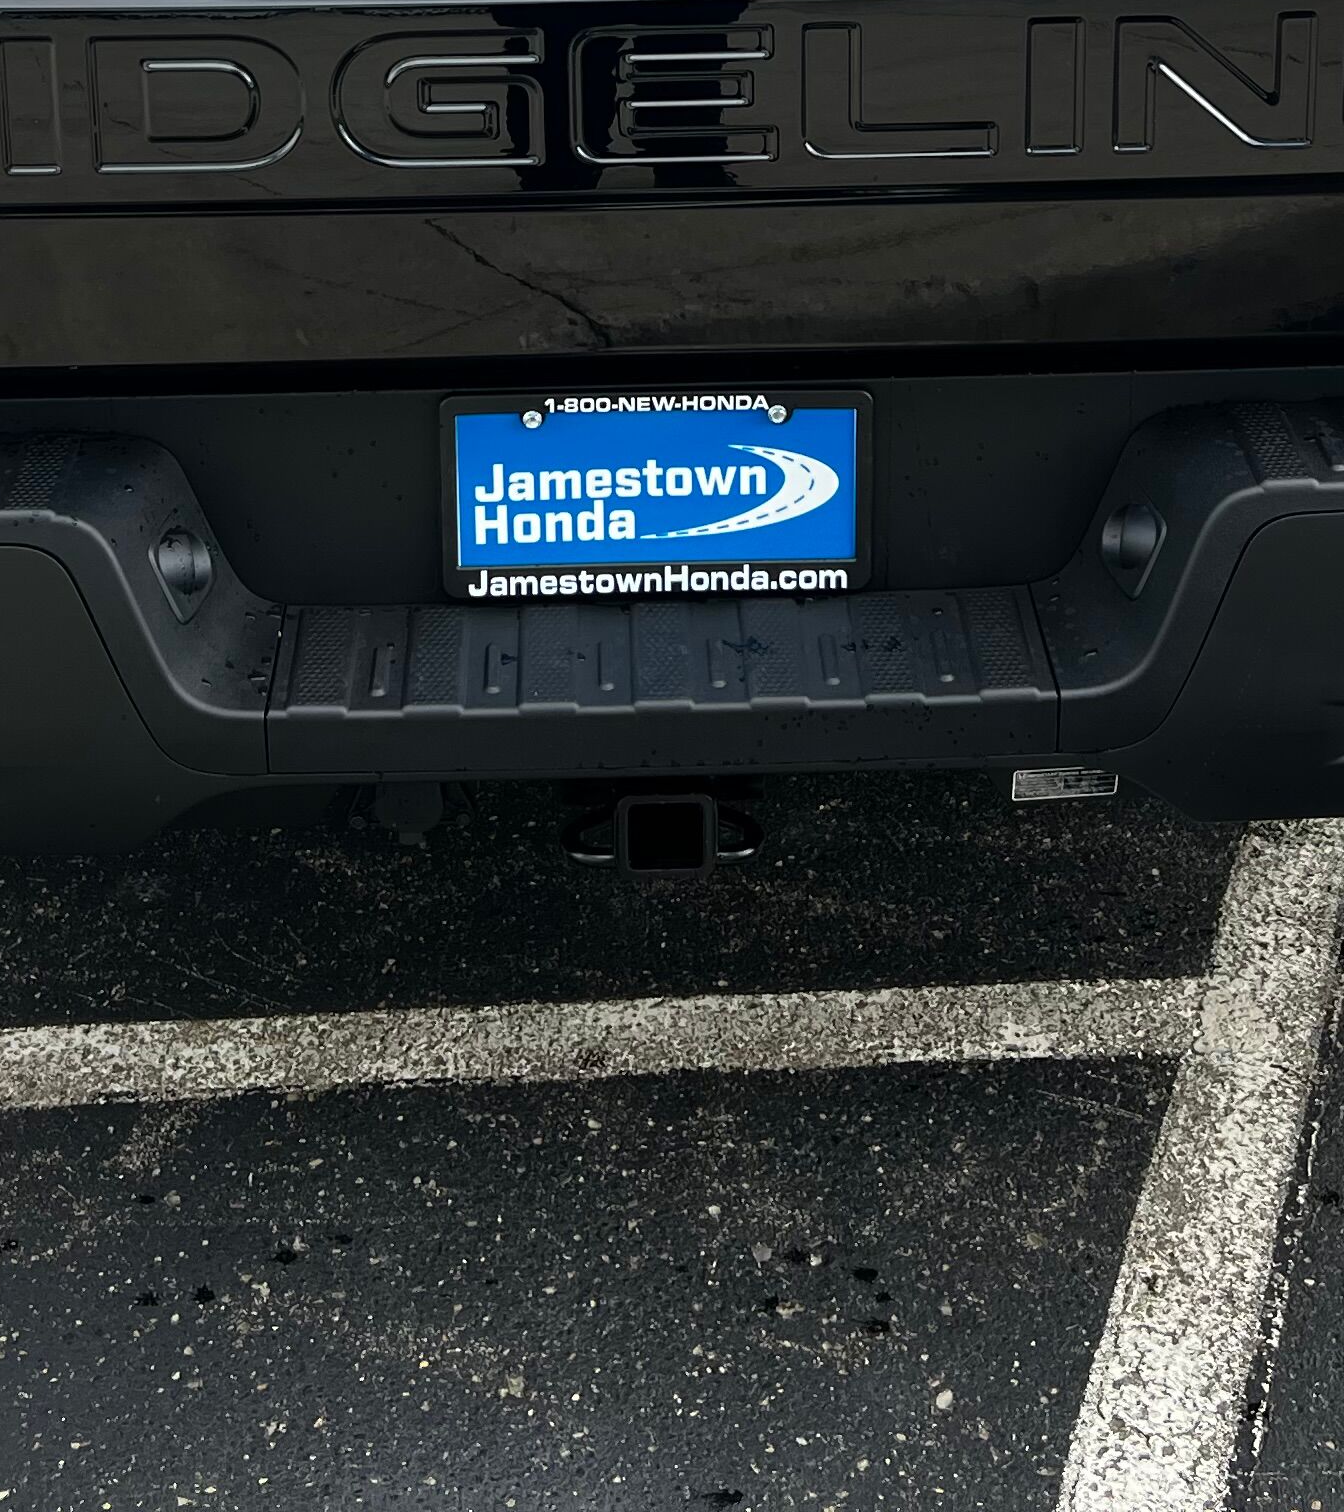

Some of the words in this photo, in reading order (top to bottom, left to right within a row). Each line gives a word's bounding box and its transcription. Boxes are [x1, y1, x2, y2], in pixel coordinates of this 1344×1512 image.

[543, 394, 769, 414] 1-800-NEW-HONDA
[474, 459, 767, 503] Jamestown
[474, 499, 636, 545] Honda
[468, 563, 848, 597] JamestownHonda.com
